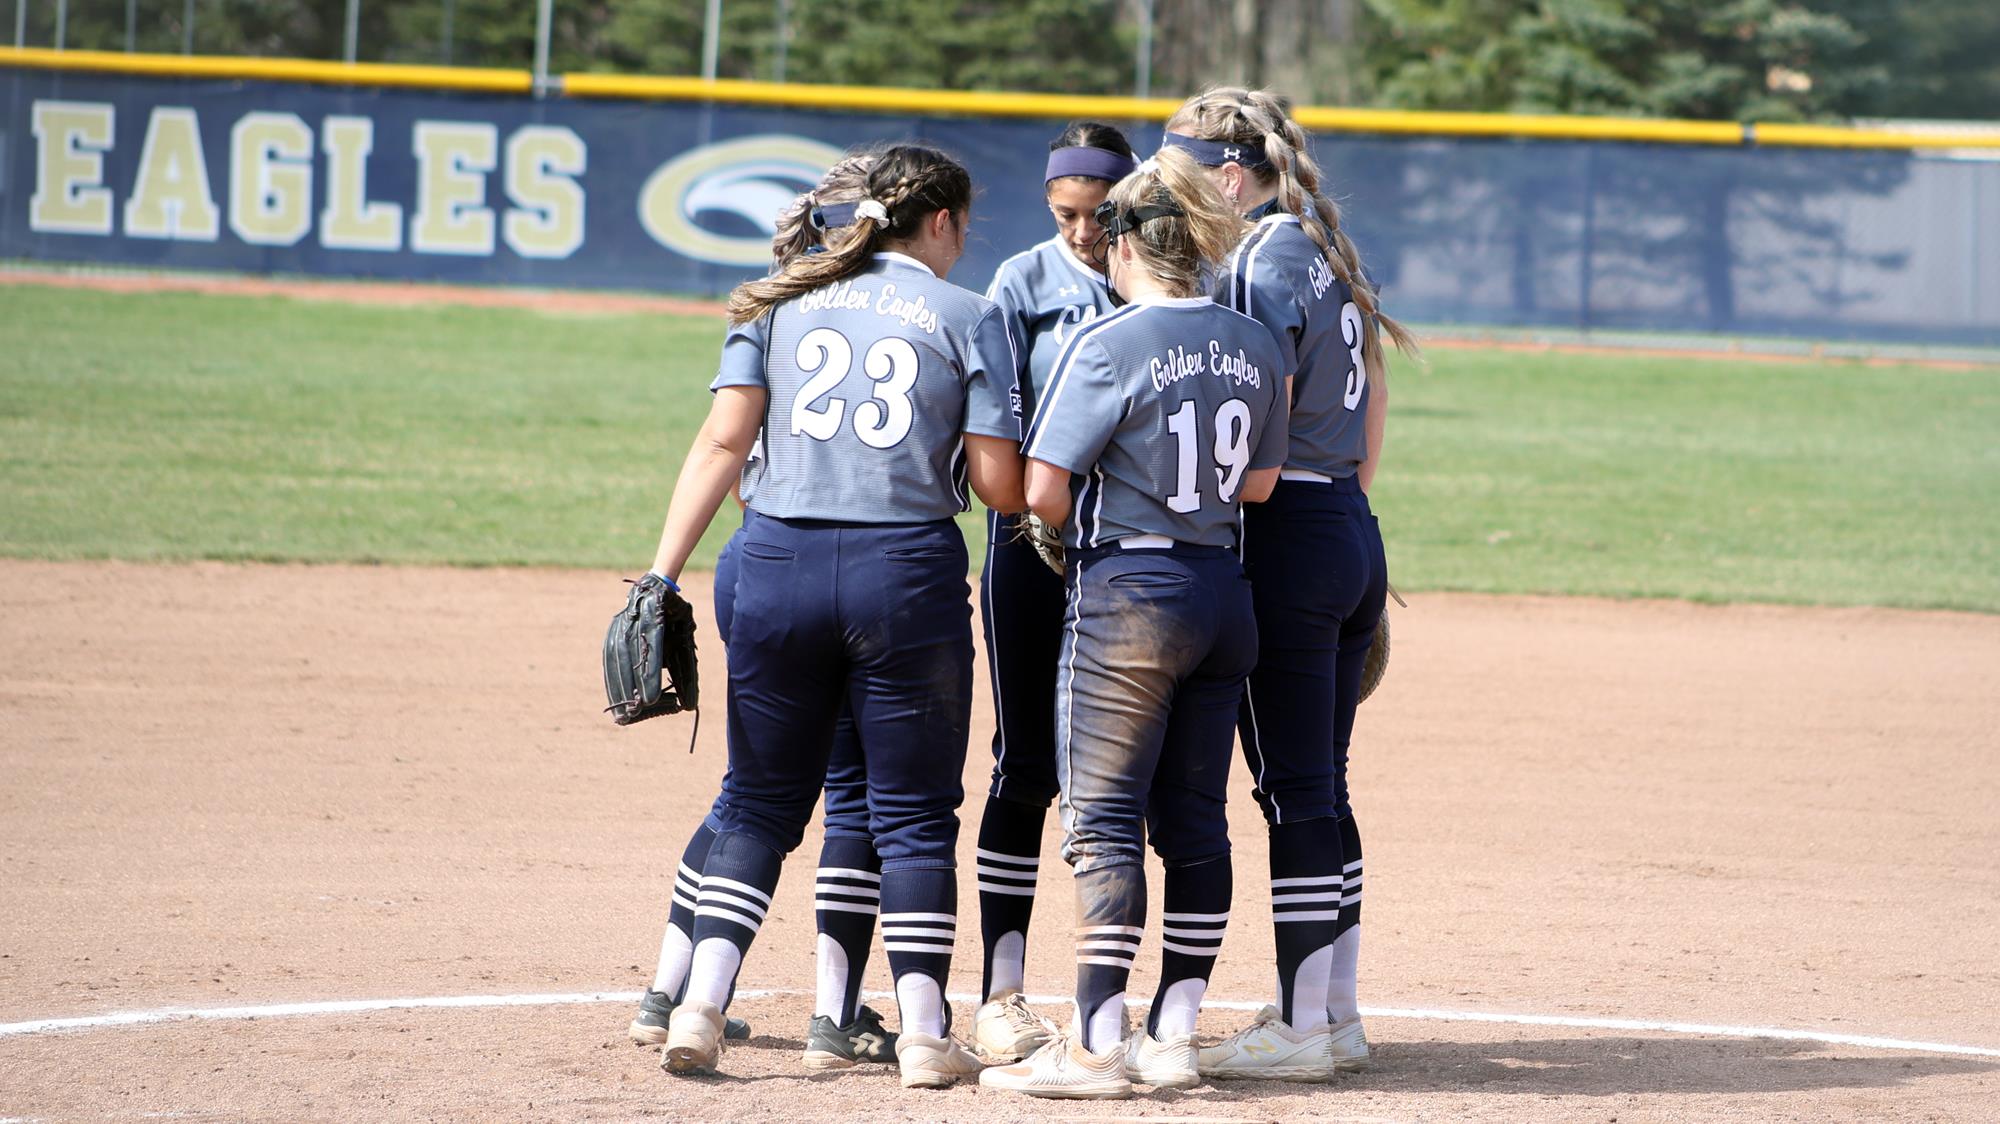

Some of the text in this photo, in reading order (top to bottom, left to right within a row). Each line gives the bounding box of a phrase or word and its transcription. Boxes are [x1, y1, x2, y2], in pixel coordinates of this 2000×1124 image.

[30, 100, 587, 259] EAGLES
[875, 283, 937, 334] Eagles
[1340, 302, 1366, 412] 3
[791, 327, 919, 450] 23
[1150, 339, 1261, 393] Golden Eagles
[1166, 398, 1252, 514] 19
